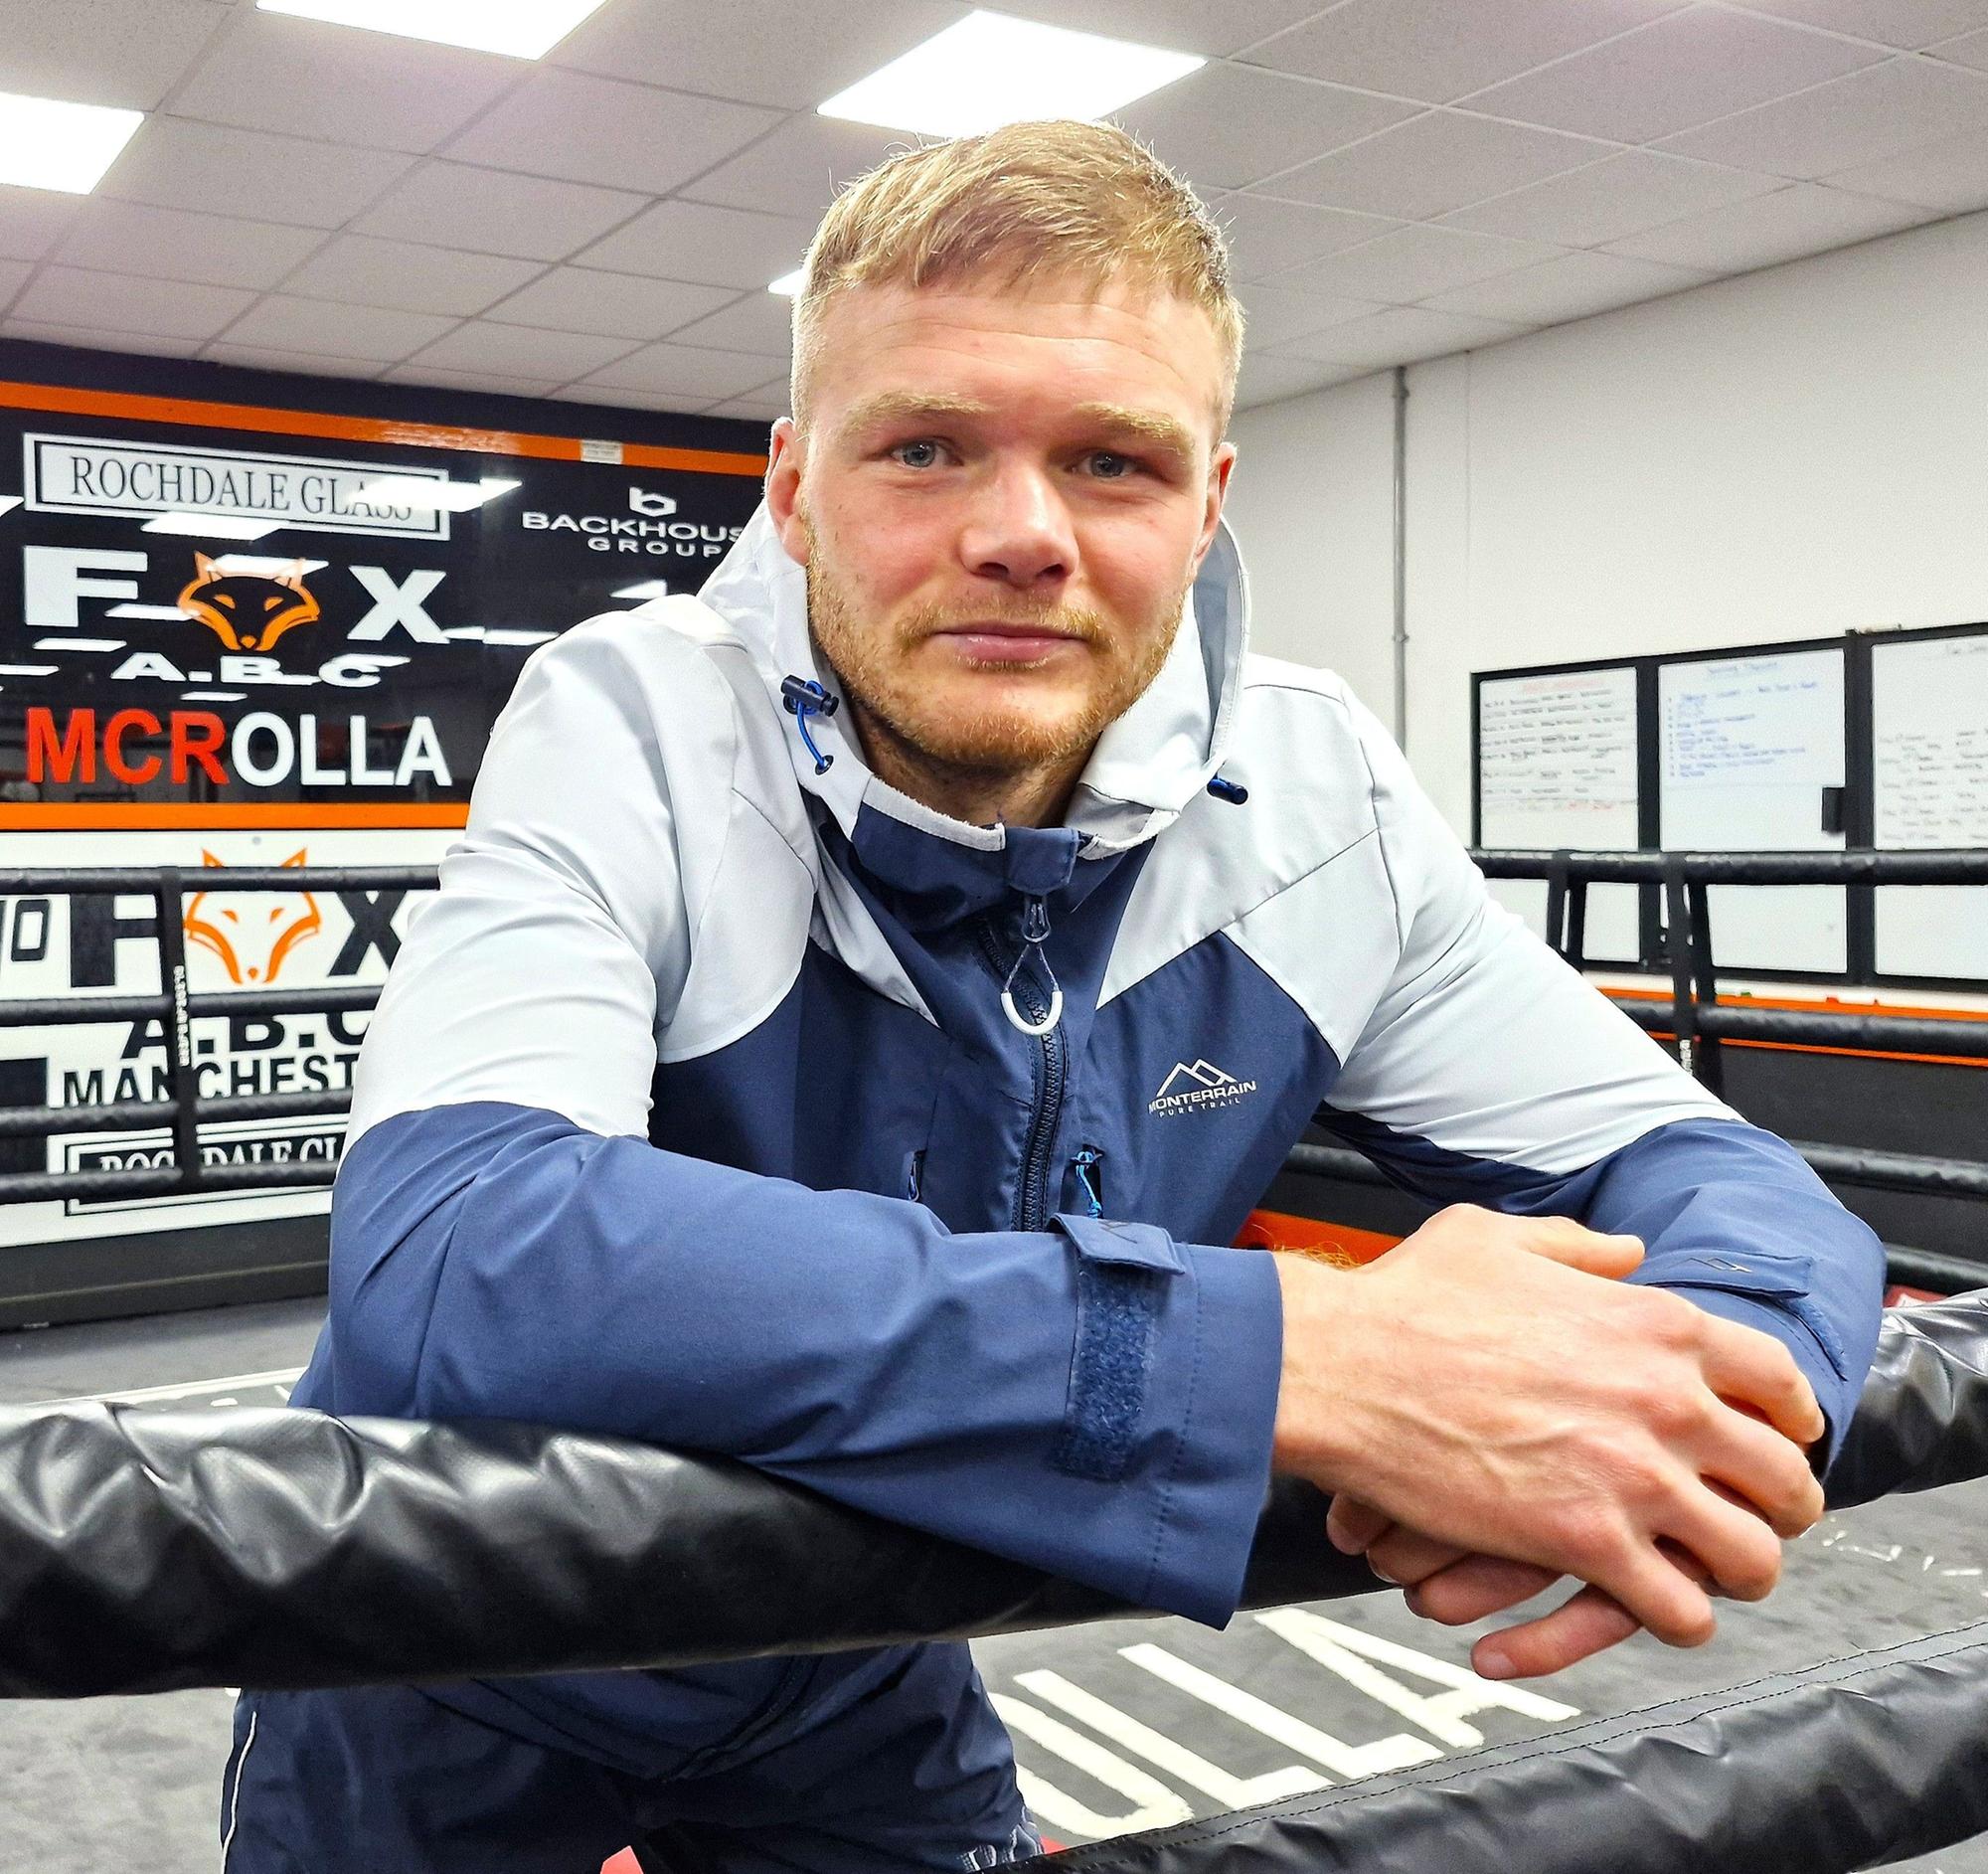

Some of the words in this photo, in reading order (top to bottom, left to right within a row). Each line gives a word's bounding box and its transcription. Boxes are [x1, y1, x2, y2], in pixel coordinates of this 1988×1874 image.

[71, 456, 289, 511] ROCHDALE
[587, 537, 722, 558] GROUP
[26, 707, 453, 786] MCROLLA
[1159, 1106, 1194, 1118] PURE
[1200, 1097, 1242, 1110] TRAIL
